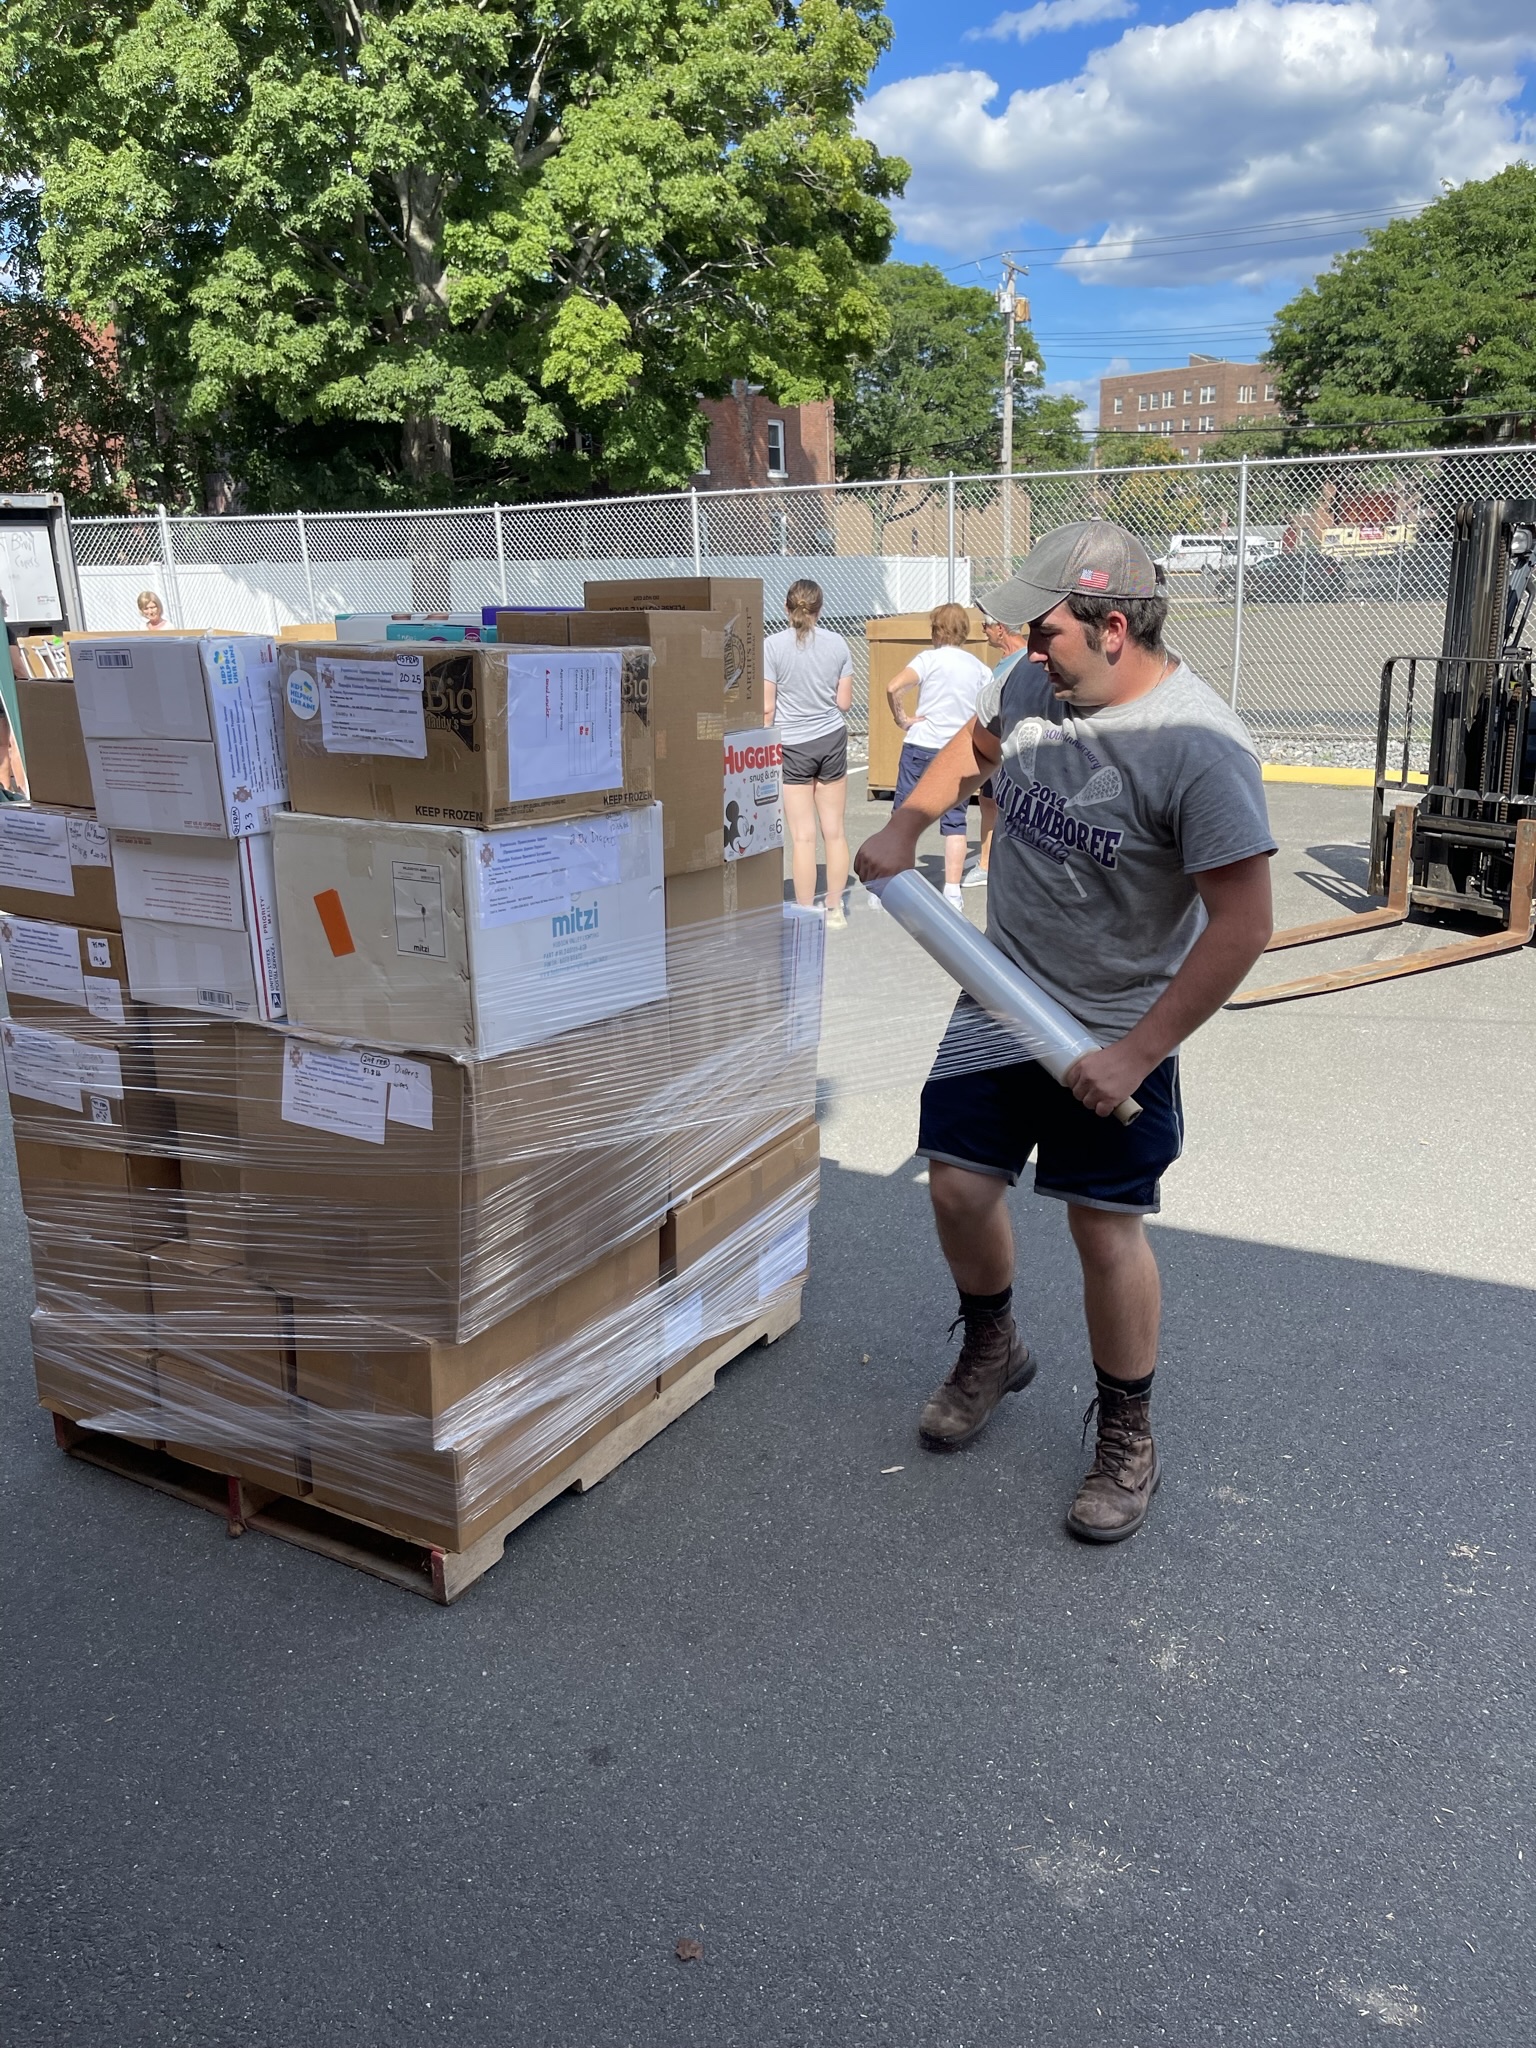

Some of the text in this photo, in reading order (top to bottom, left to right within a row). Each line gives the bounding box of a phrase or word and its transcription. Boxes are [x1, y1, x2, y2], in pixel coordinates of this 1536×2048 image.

[219, 666, 227, 685] KIDS
[223, 649, 233, 685] HELPING
[228, 645, 239, 684] UKRAINE
[290, 682, 303, 691] KIDS
[290, 689, 313, 703] HELPING
[621, 670, 650, 705] Big
[290, 697, 316, 712] UKRAINE
[424, 675, 477, 726] Big
[724, 743, 783, 776] HUGGIES
[749, 769, 780, 783] snug & dry
[603, 791, 652, 806] KEEP FROZEN
[1028, 782, 1068, 812] 2014
[415, 805, 441, 817] KEEP
[443, 808, 483, 822] FROZEN
[775, 819, 782, 834] 6
[1006, 786, 1122, 869] JAMBOREE
[260, 898, 268, 934] PRIORITY
[552, 900, 598, 938] mitzi
[413, 944, 430, 953] mitzi
